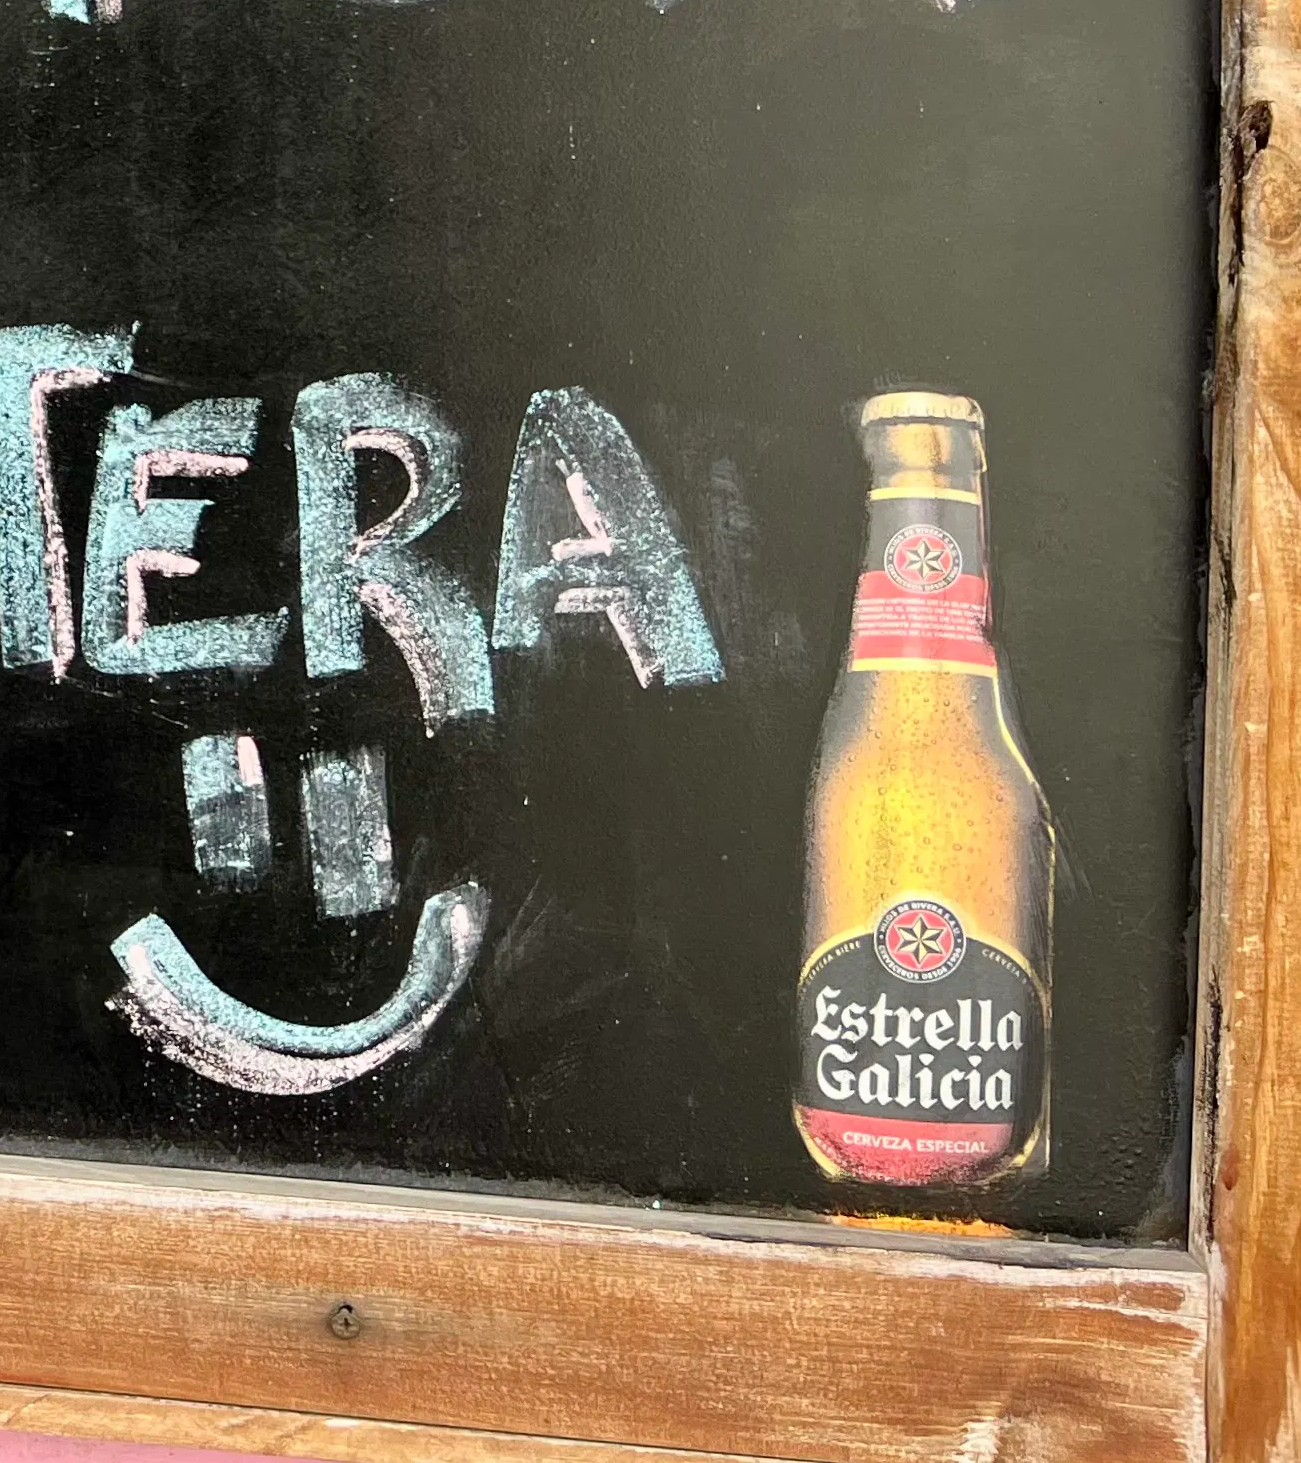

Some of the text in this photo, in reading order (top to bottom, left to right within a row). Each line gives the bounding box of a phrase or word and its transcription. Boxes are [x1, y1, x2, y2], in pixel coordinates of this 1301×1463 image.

[810, 984, 1024, 1052] Estrella
[816, 1043, 1015, 1111] Galicia
[842, 1130, 912, 1152] CERVEZA
[916, 1136, 989, 1155] ESPECIAL
